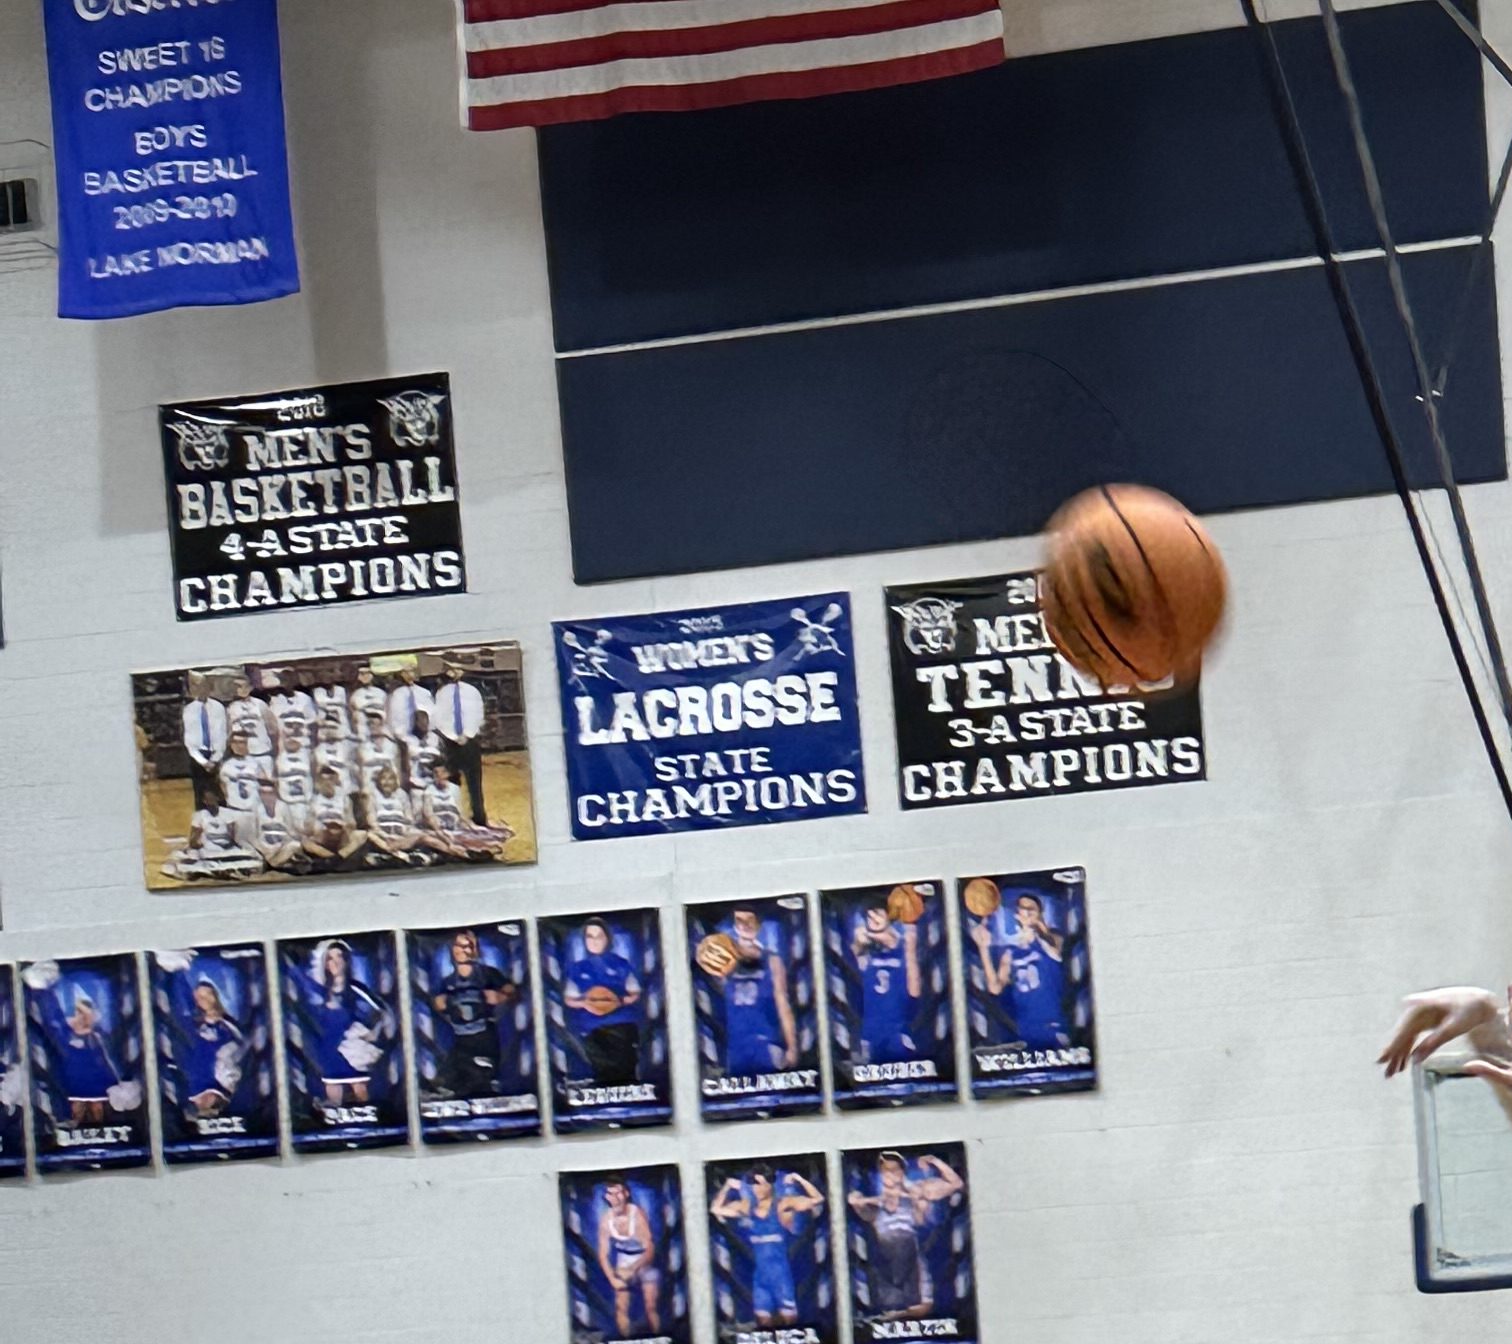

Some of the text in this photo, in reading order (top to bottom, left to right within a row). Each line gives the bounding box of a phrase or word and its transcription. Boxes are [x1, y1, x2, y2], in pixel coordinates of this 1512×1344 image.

[98, 41, 191, 74] SWEET
[85, 70, 242, 111] CHAMPIONS
[134, 124, 207, 155] BOYS
[84, 154, 258, 195] BASKETBALL
[88, 237, 269, 278] LAKE NORMAN
[243, 423, 372, 471] MEN'S
[176, 457, 455, 529] BASKETBALL
[219, 516, 409, 560] 4-A STATE
[180, 550, 462, 613] CHAMPIONS
[631, 633, 775, 673] WOMEN'S
[915, 653, 1175, 713] TENN
[574, 671, 841, 746] LACROSSE
[948, 701, 1147, 748] 3-A STATE
[654, 747, 772, 781] STATE
[903, 737, 1200, 801] CHAMPIONS
[577, 769, 857, 827] CHAMPIONS
